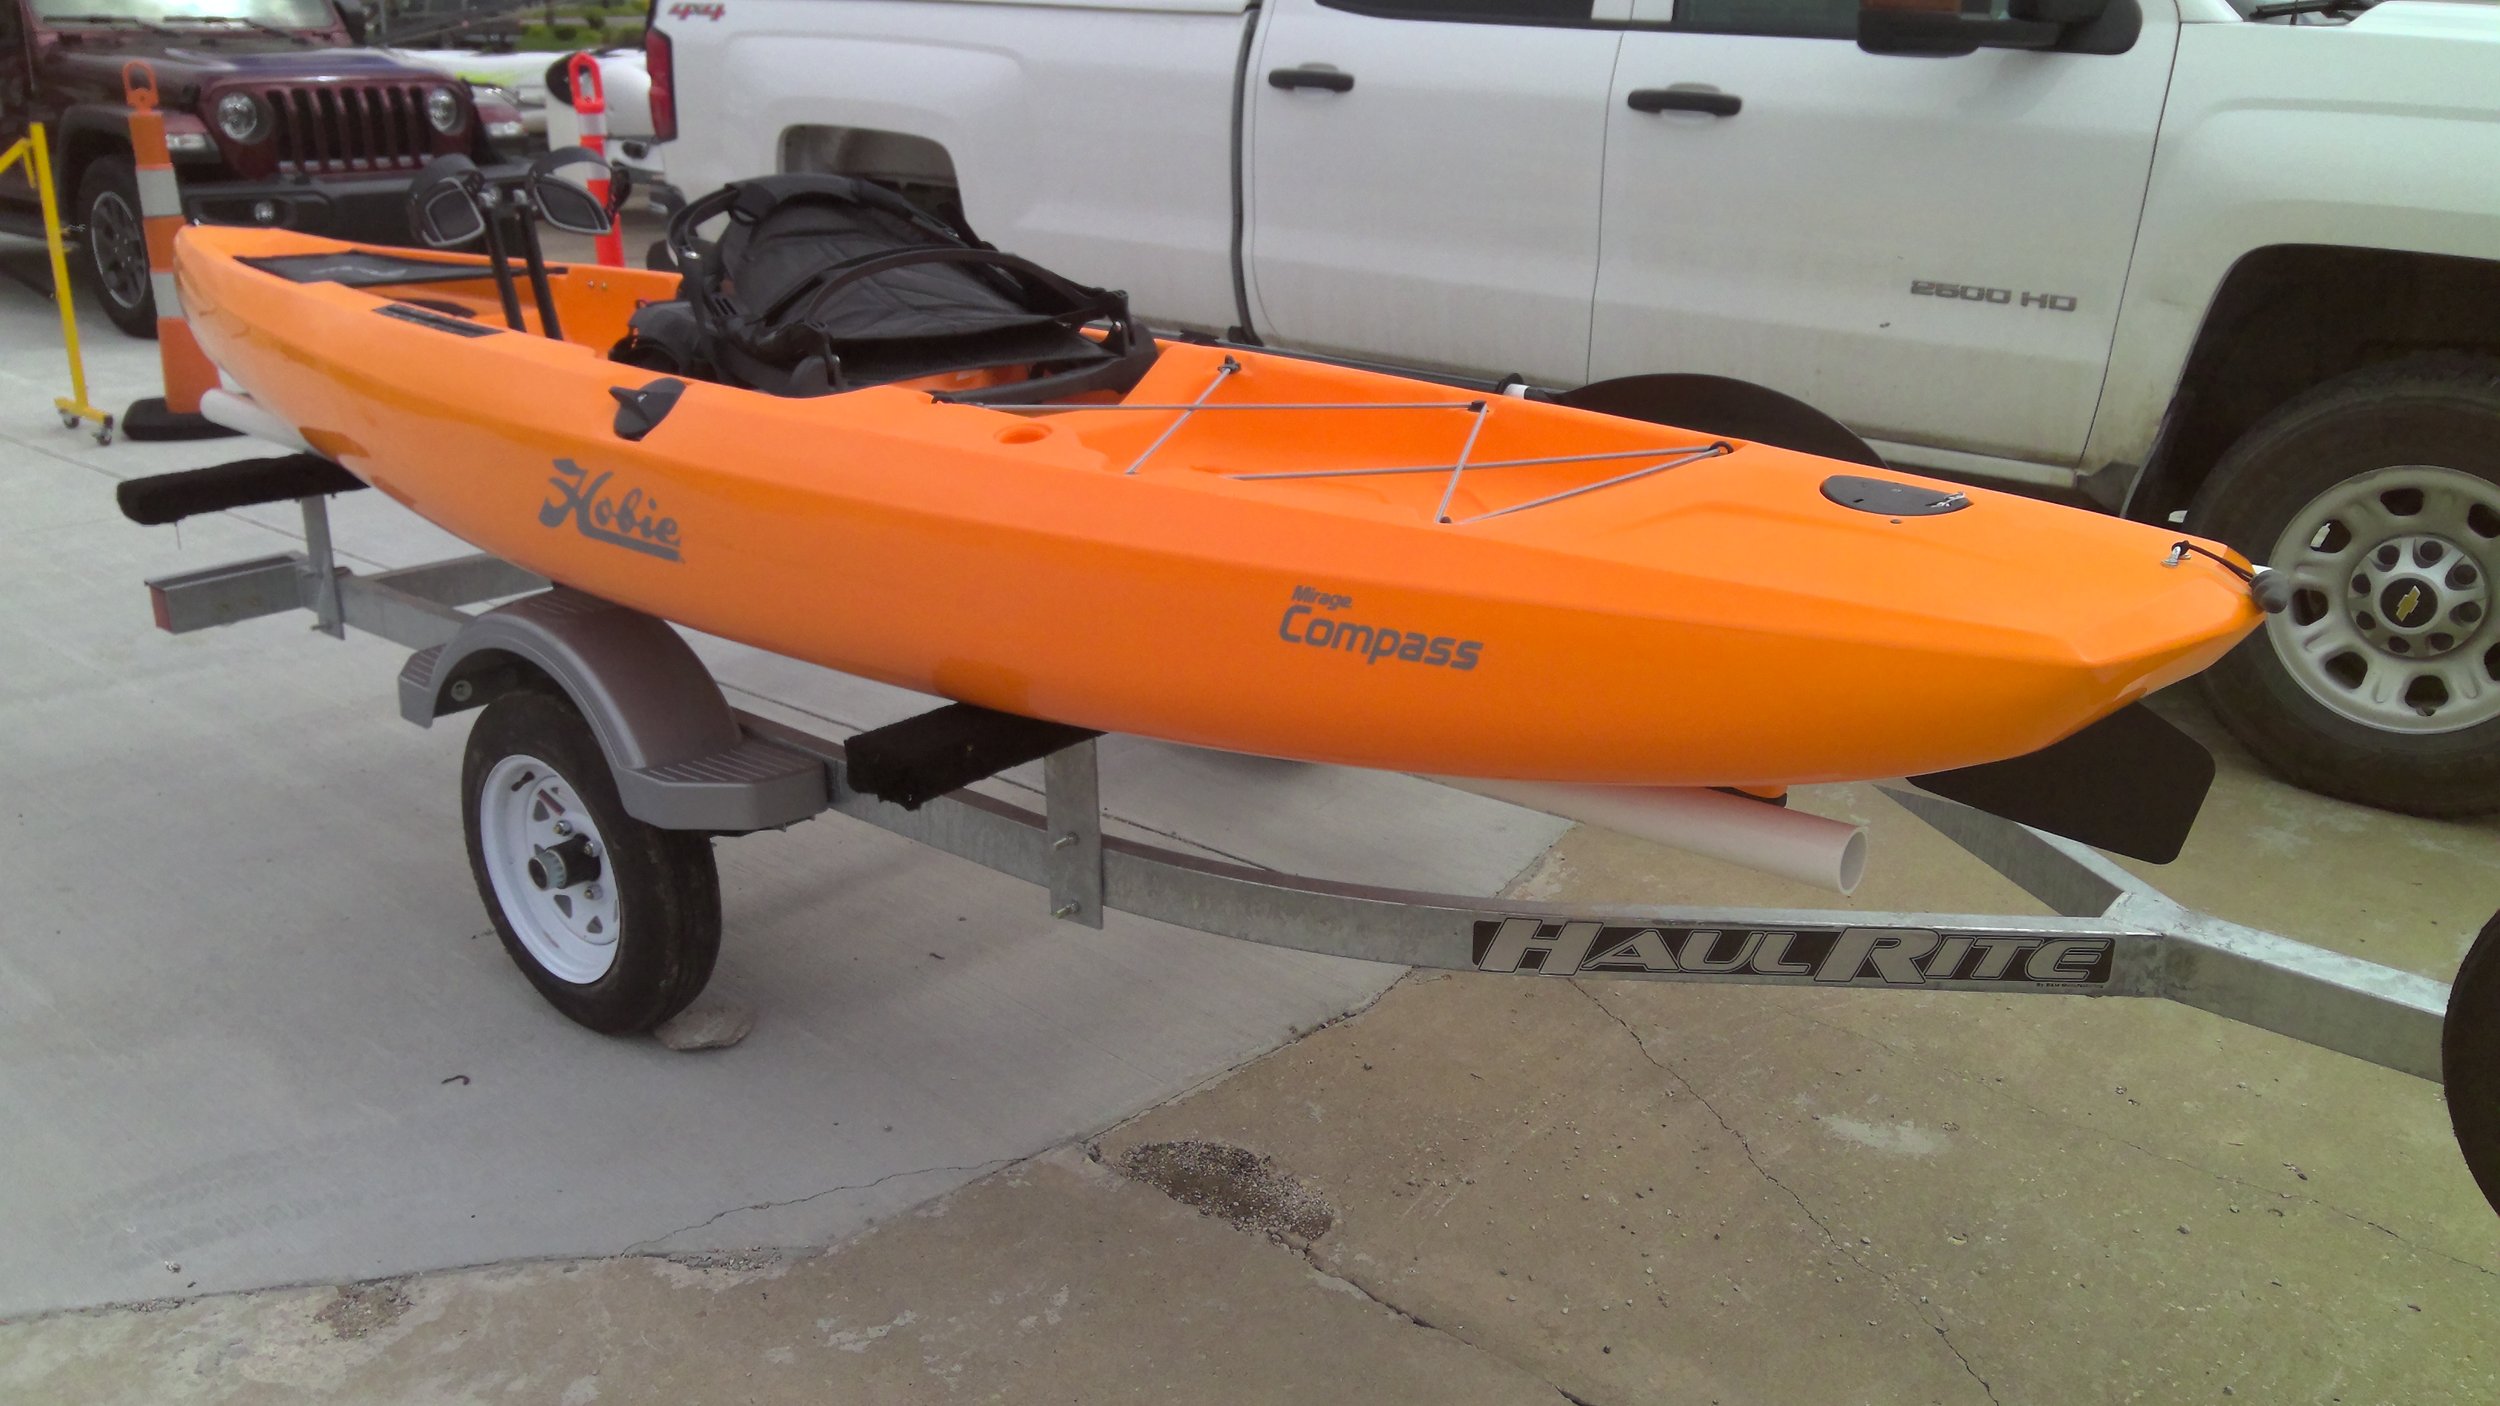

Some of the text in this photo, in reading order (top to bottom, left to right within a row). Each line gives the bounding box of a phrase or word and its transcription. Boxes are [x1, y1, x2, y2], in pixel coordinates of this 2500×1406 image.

[1910, 280, 2078, 311] 2500 HD
[538, 459, 684, 563] Hobie
[1292, 585, 1353, 610] Mirage
[1279, 605, 1484, 671] Compass
